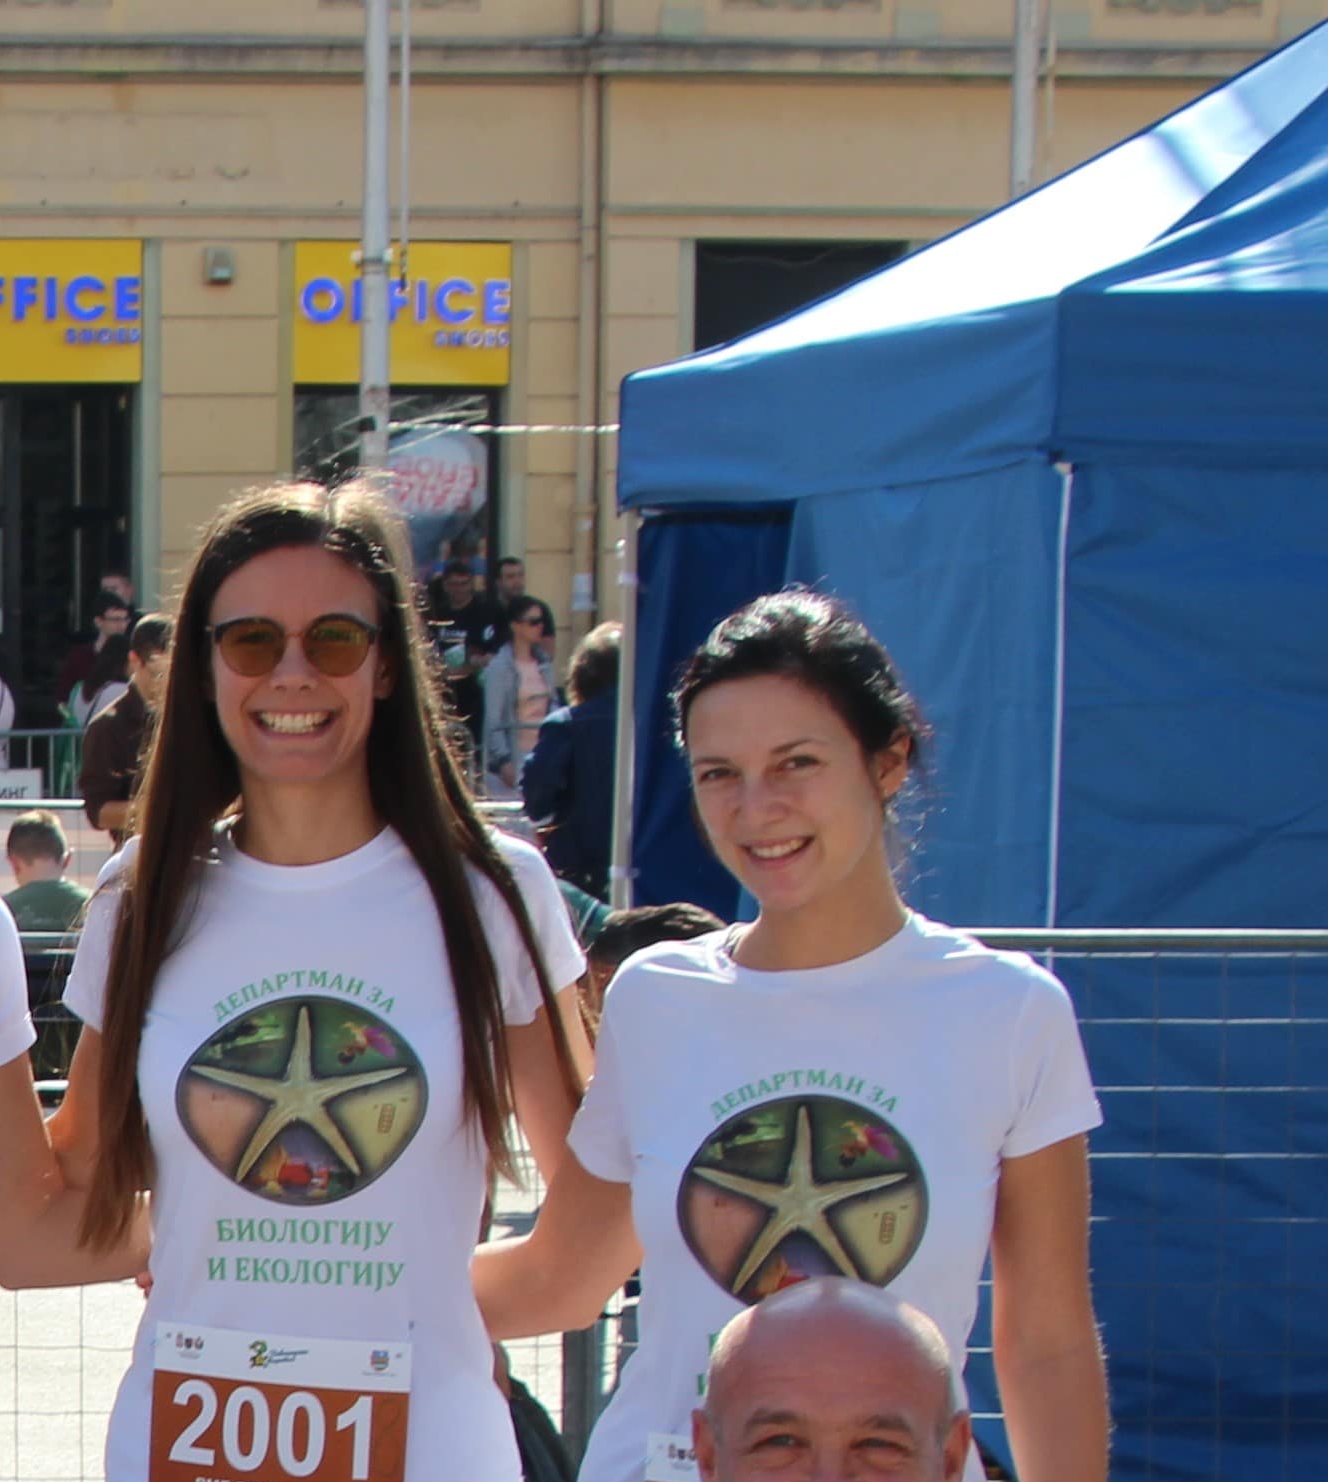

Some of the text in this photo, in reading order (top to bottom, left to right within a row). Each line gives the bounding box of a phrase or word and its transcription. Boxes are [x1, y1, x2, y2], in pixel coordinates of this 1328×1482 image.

[213, 969, 396, 1023] ДЕПАРТМАН ЗА
[710, 1068, 898, 1121] ДЕПАРТМАН ЗА
[217, 1217, 395, 1251] БИОЛОГИЈУ
[206, 1256, 406, 1292] И ЕКОЛОГИЈУ
[168, 1378, 374, 1481] 2001
